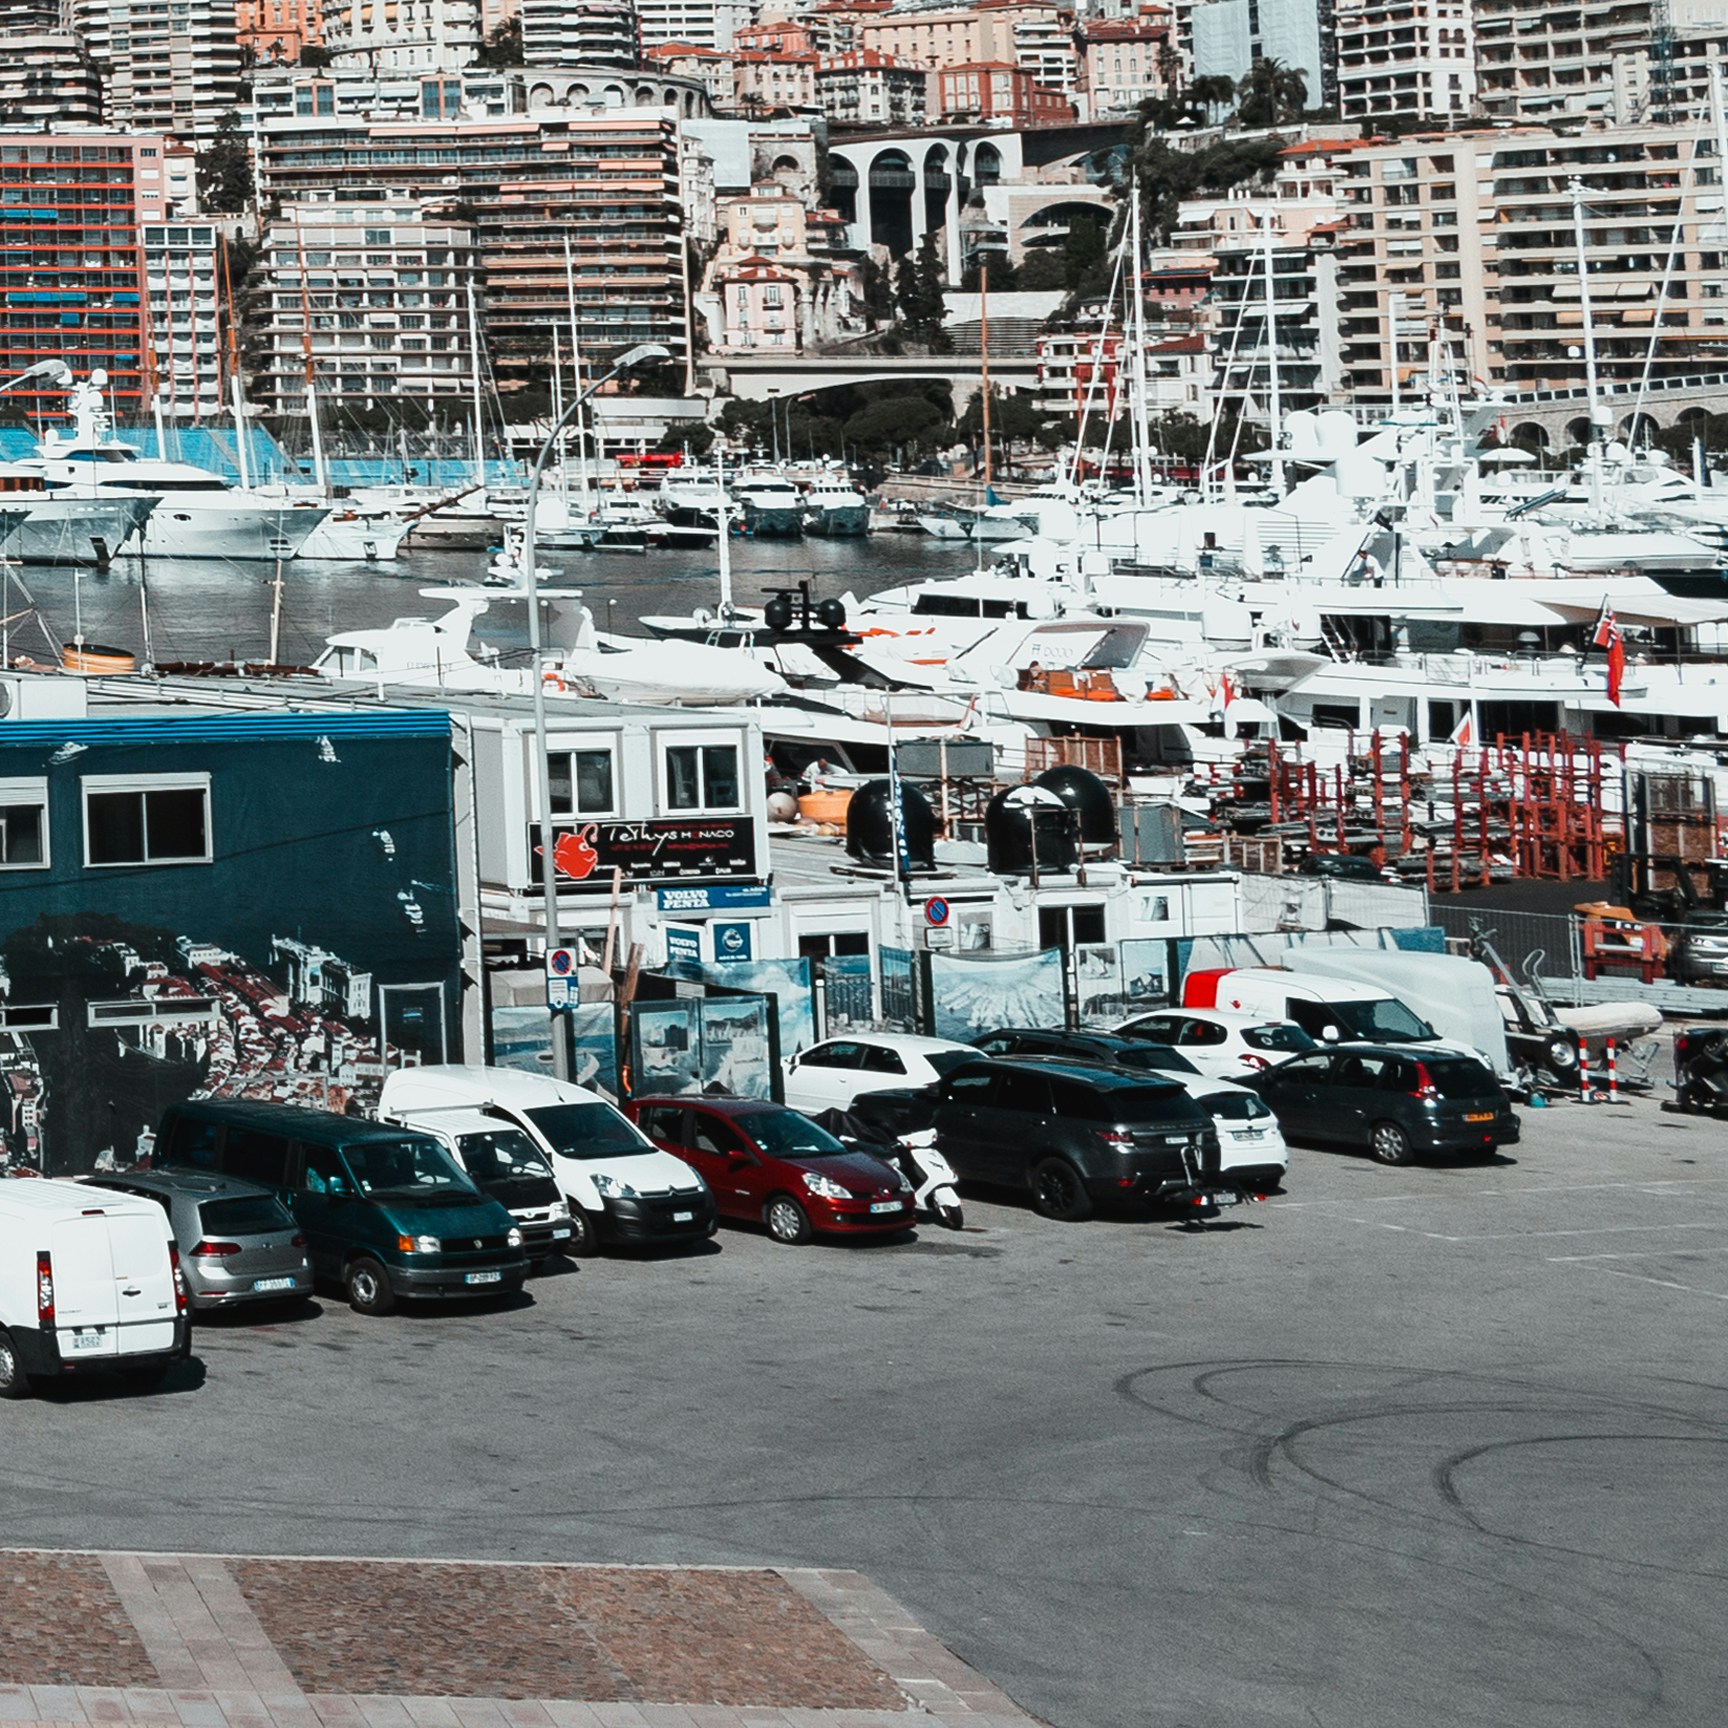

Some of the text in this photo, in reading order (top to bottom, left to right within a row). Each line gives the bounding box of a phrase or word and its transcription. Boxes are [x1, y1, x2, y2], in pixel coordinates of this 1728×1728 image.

[681, 829, 734, 839] MONACO
[662, 889, 708, 900] VOLVO
[662, 899, 710, 909] PENTA
